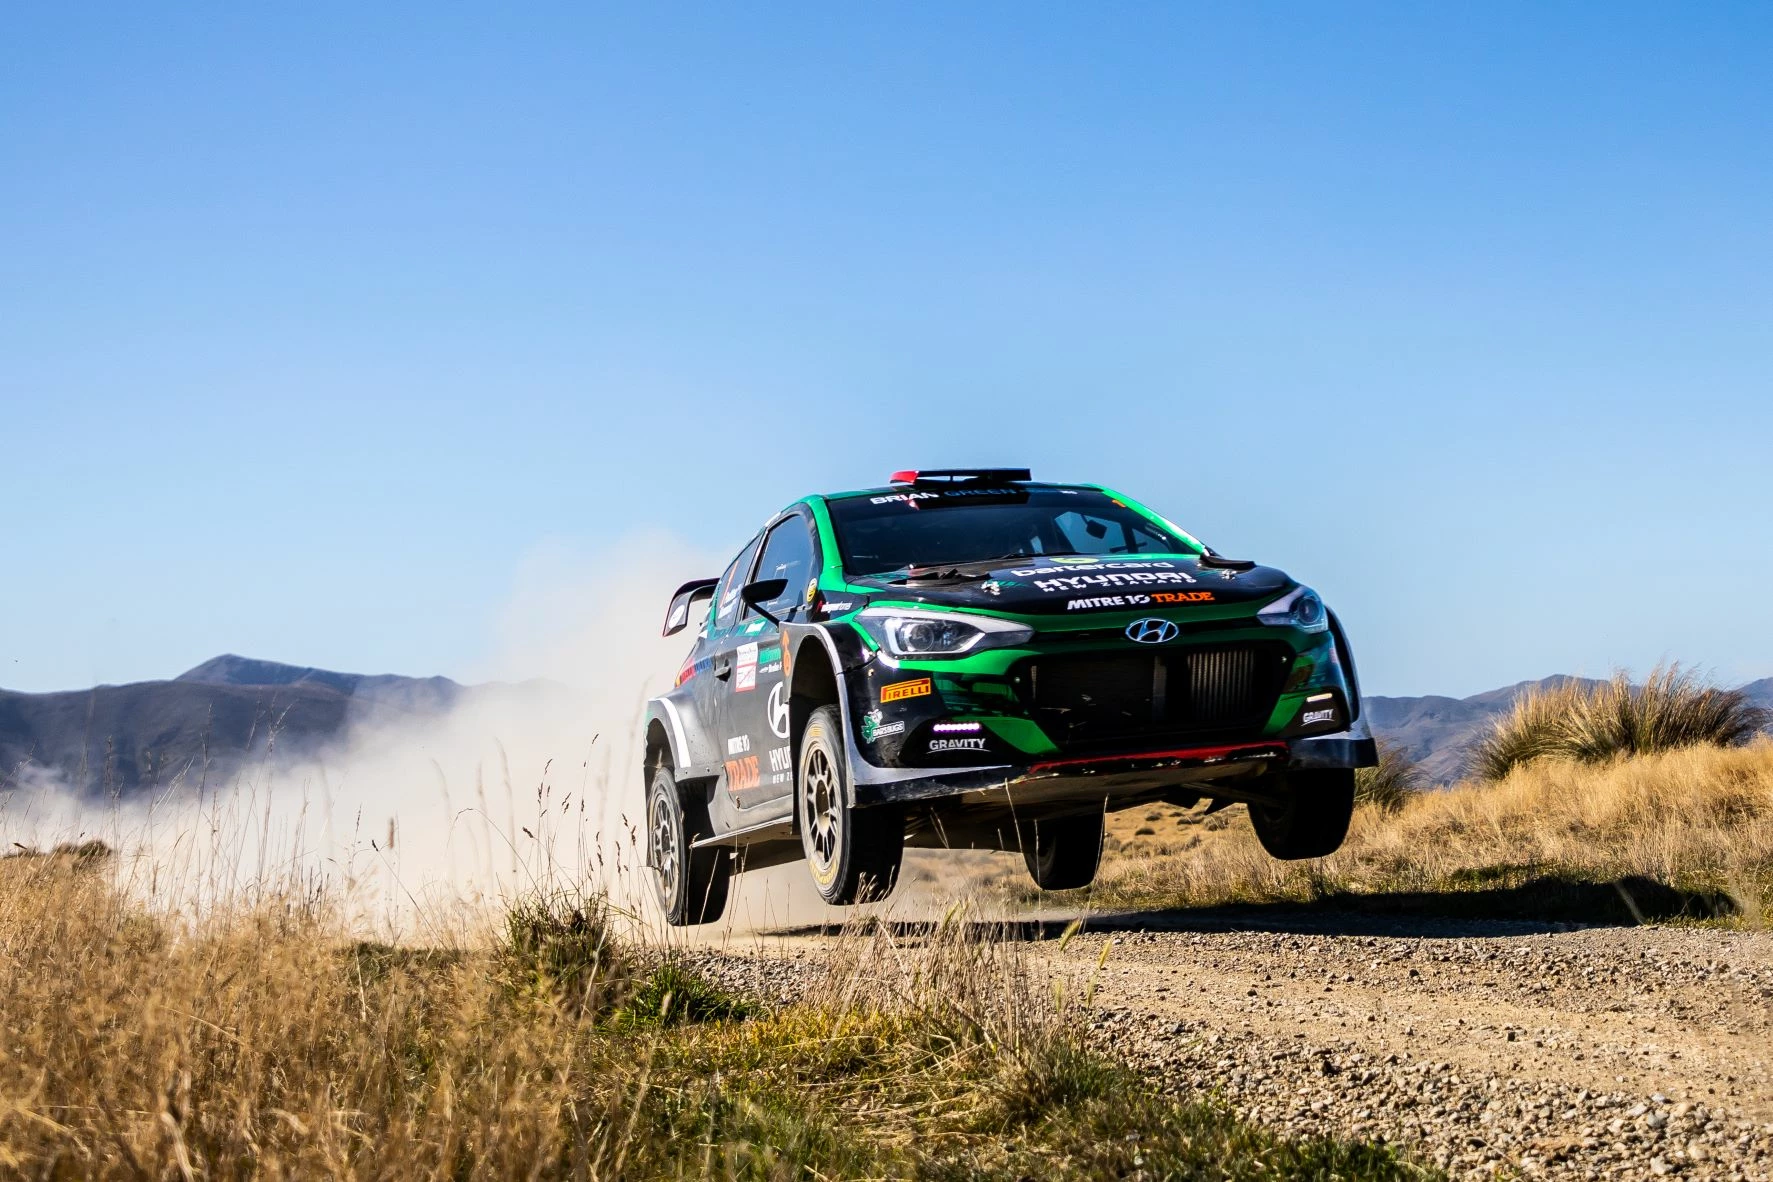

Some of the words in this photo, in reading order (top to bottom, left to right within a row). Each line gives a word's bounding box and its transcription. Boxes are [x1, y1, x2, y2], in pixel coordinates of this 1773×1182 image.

[869, 492, 939, 505] BRIAN
[943, 488, 1018, 497] GREEN
[1011, 561, 1175, 577] bartercard
[1033, 572, 1193, 589] HYUNDAI
[1043, 583, 1087, 593] NEW
[1102, 578, 1197, 587] ZEALAND
[1067, 593, 1122, 610] MITRE
[1125, 594, 1151, 604] 10
[1151, 591, 1215, 603] TRADE
[881, 678, 931, 703] PIRELLI
[1303, 709, 1334, 722] GRAVITY
[929, 738, 986, 750] GRAVITY
